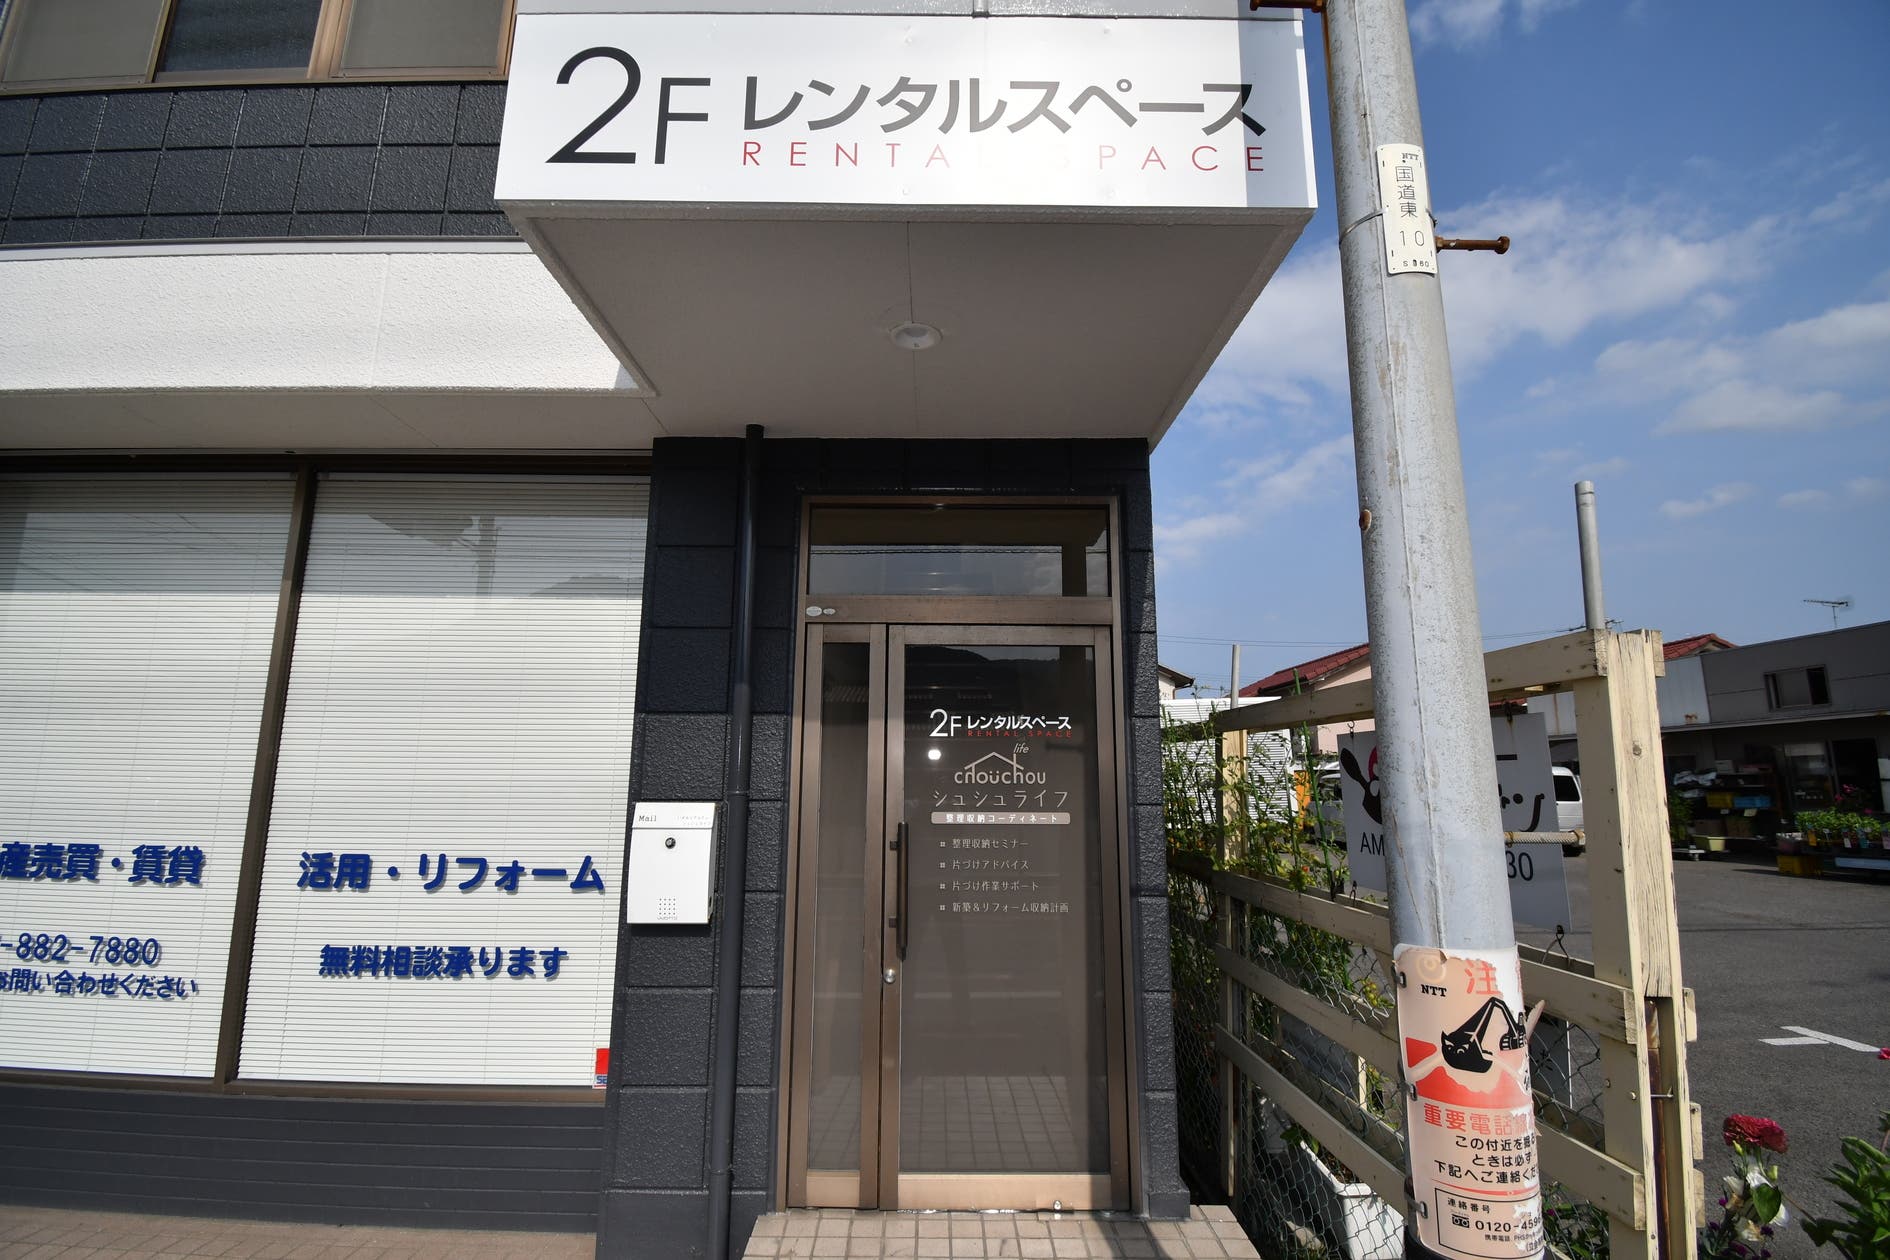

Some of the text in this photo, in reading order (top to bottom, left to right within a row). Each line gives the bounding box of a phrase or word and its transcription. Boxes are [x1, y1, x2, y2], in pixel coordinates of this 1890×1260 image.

[545, 46, 1267, 165] 2F レンタルスペース
[743, 140, 1265, 173] RENTA PACE
[1395, 166, 1418, 218] 国道東
[1399, 230, 1425, 247] 10
[929, 708, 1072, 737] 2F レンタルスペース
[1013, 743, 1030, 754] life
[932, 789, 1068, 808] シュシュライフ
[945, 814, 1057, 823] 整理収納コーディネート
[952, 839, 1029, 849] 整理収納セミナー
[297, 851, 605, 890] 活用・リフォーム
[952, 860, 1029, 870] 片づけアドバイス
[952, 881, 1039, 891] 片づけ作業サポート
[0, 932, 160, 966] -882-7880
[318, 943, 568, 978] 無料相談承ります
[1420, 984, 1447, 997] NTT
[1447, 1197, 1490, 1214] 連絡番号
